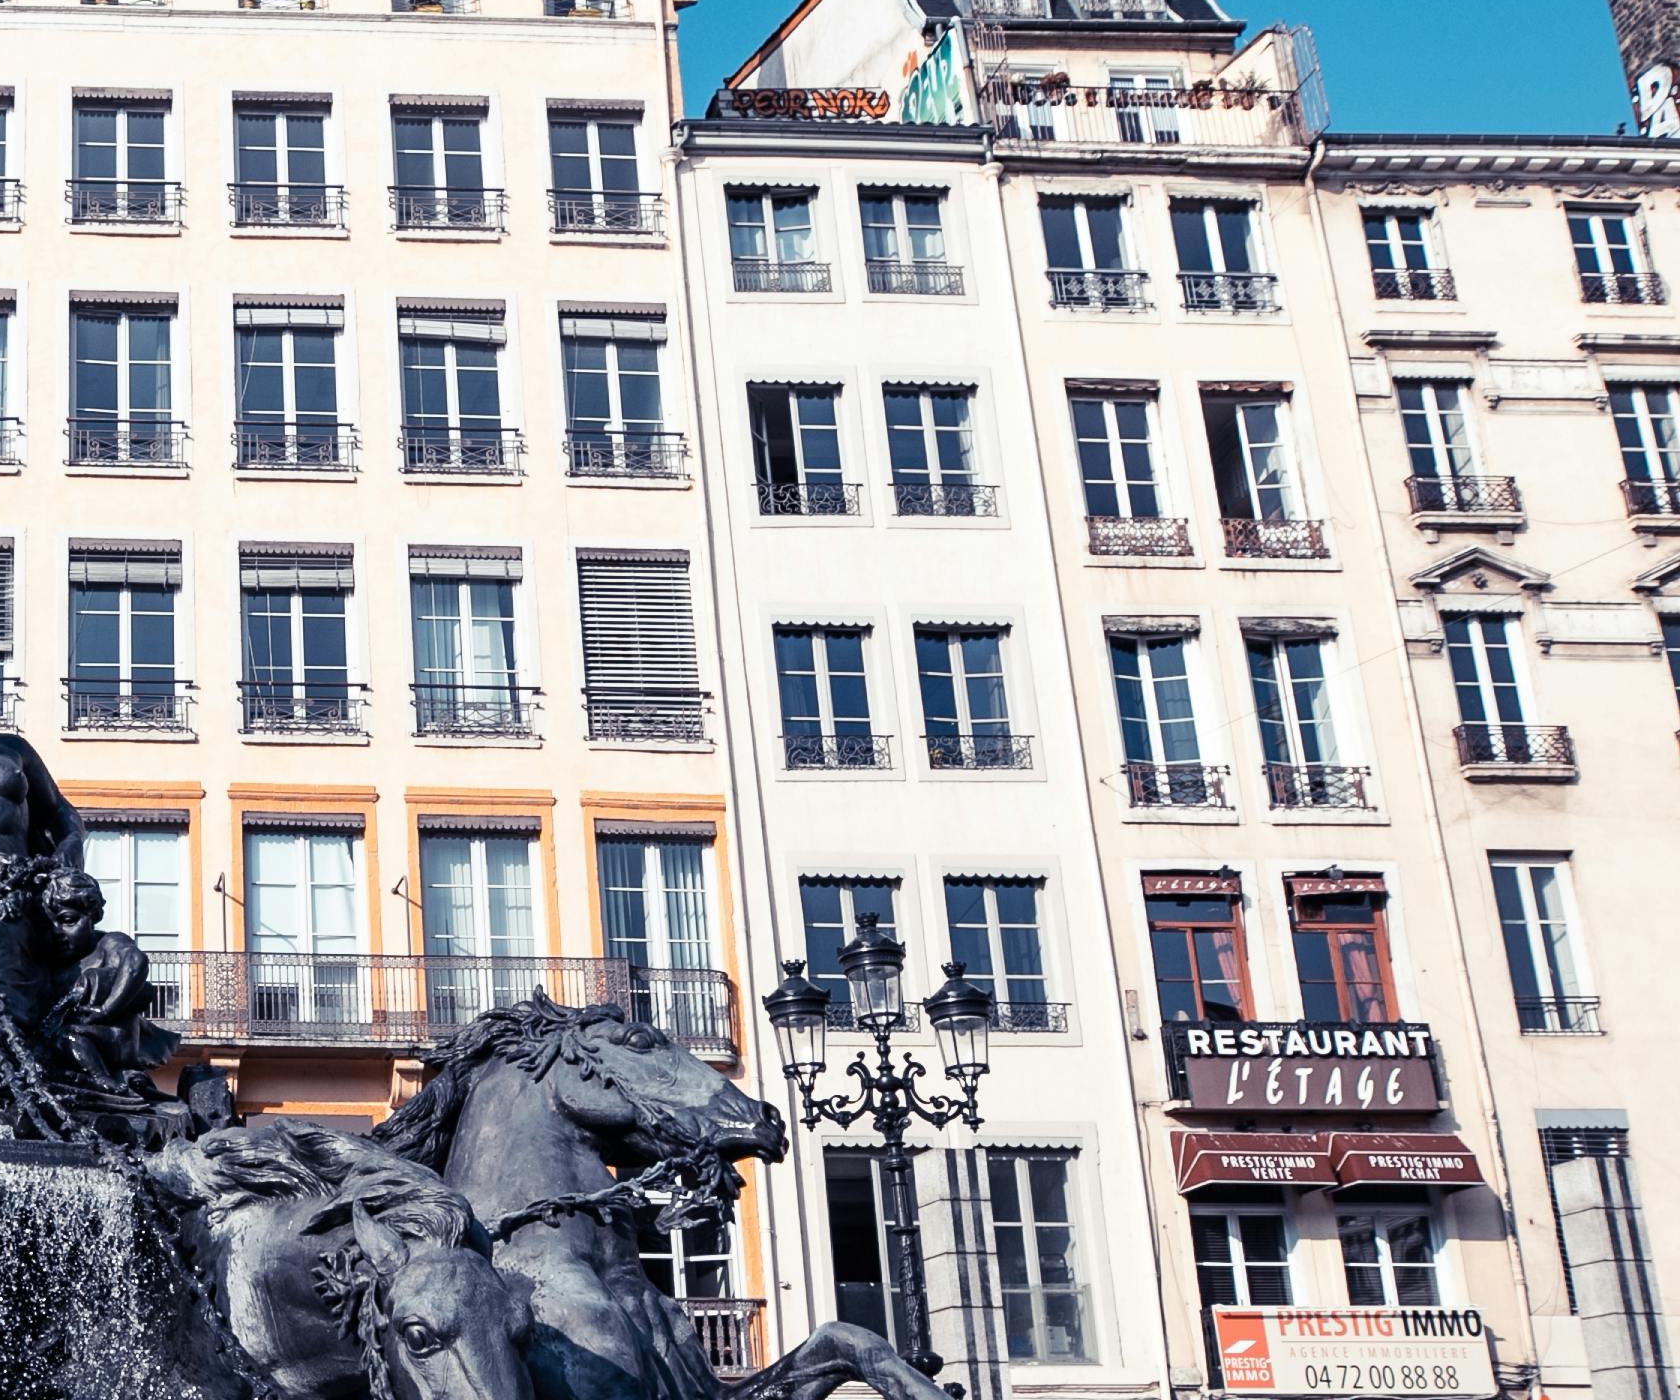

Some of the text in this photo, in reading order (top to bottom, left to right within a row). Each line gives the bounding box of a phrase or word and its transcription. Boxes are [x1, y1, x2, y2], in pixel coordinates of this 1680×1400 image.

[1188, 1029, 1429, 1057] RESTAURANT
[1226, 1058, 1404, 1109] L'ÉTAGE
[1221, 1155, 1316, 1169] PRESTIG'IMMO
[1369, 1155, 1464, 1169] PRESTIG'IMMO
[1250, 1167, 1294, 1180] VENTE
[1400, 1167, 1441, 1180] ACHAT
[1278, 1309, 1483, 1338] PRESTIG'IMMO
[1290, 1347, 1469, 1360] AGENCE IMMOBILIERE
[1226, 1369, 1270, 1382] IMMO
[1305, 1365, 1459, 1390] 04 72 00 88 88
